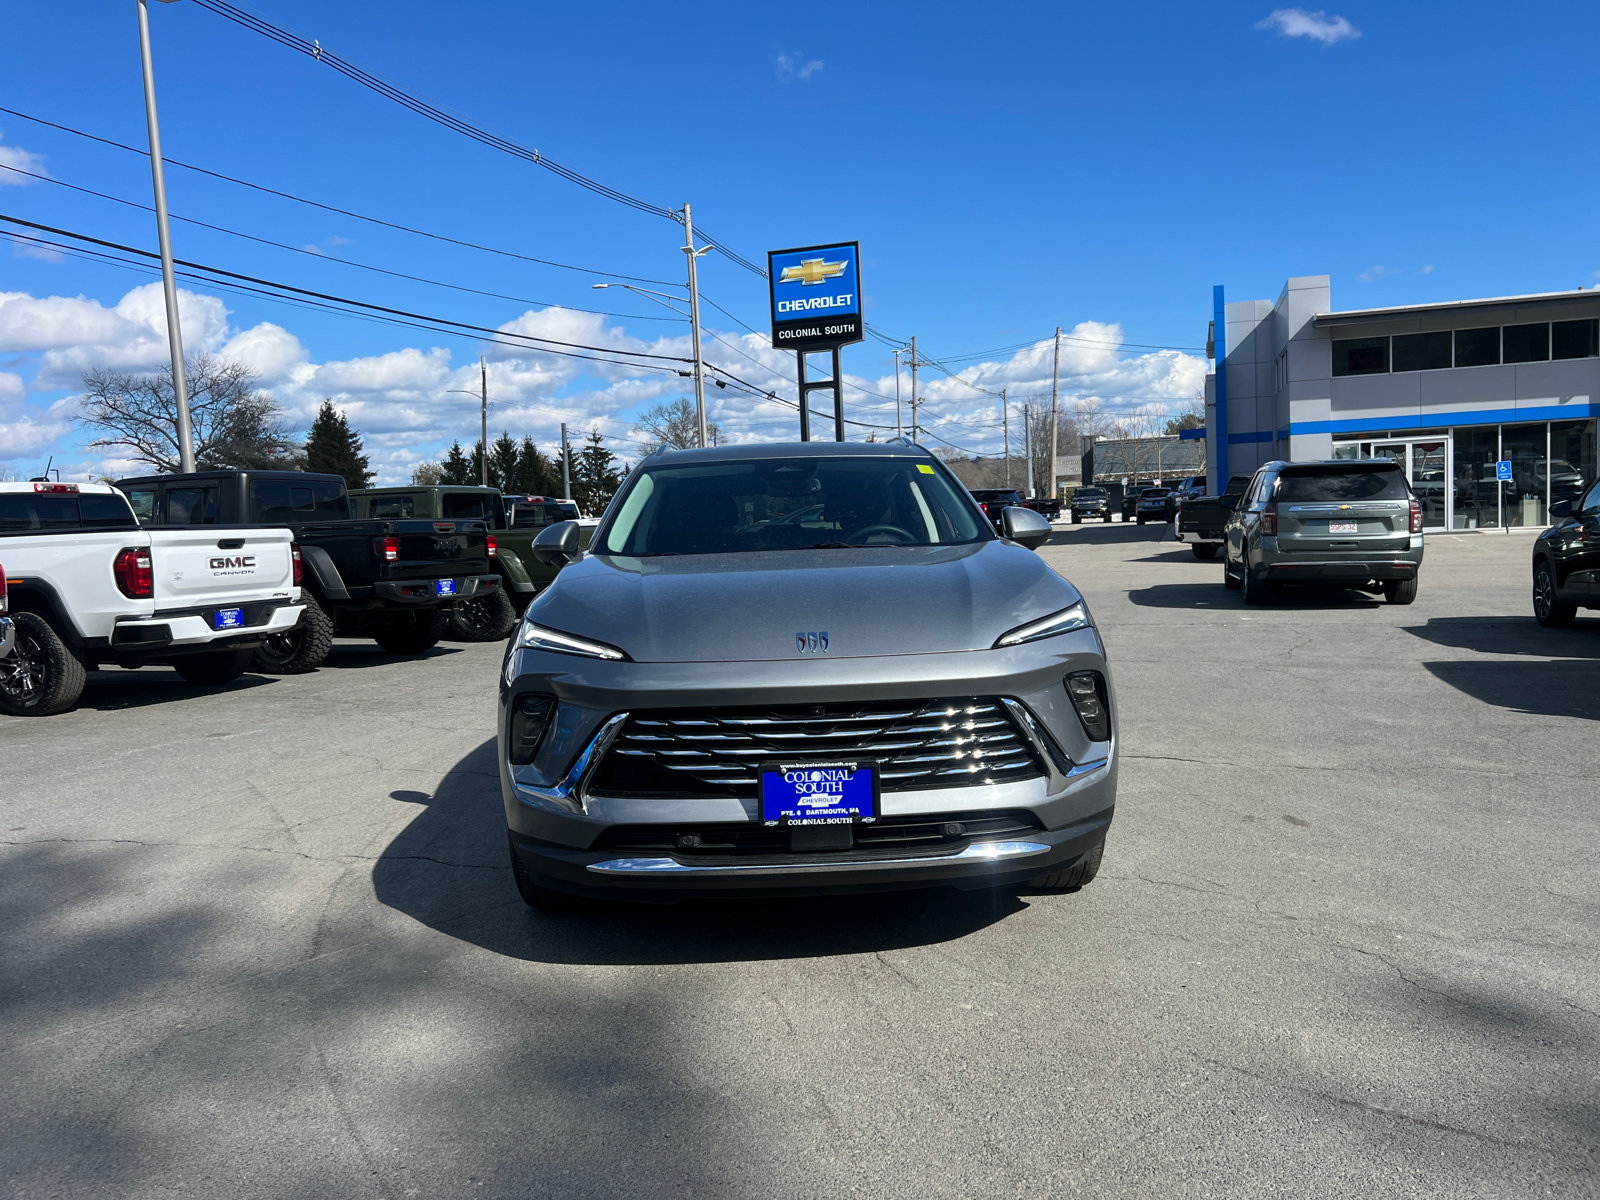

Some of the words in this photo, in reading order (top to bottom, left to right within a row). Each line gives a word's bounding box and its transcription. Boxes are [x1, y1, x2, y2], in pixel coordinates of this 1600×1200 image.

[778, 294, 853, 313] CHEVROLET
[779, 327, 822, 339] COLONIAL
[825, 324, 855, 335] SOUTH
[433, 538, 458, 552] Jeep
[209, 556, 256, 569] GMC
[784, 769, 853, 783] COLONIAL
[795, 781, 843, 794] SOUTH
[801, 796, 838, 804] CHEVROLET
[806, 808, 848, 816] DARTMOUTH,
[787, 818, 827, 826] COLONIAL
[826, 817, 853, 825] SOUTH
